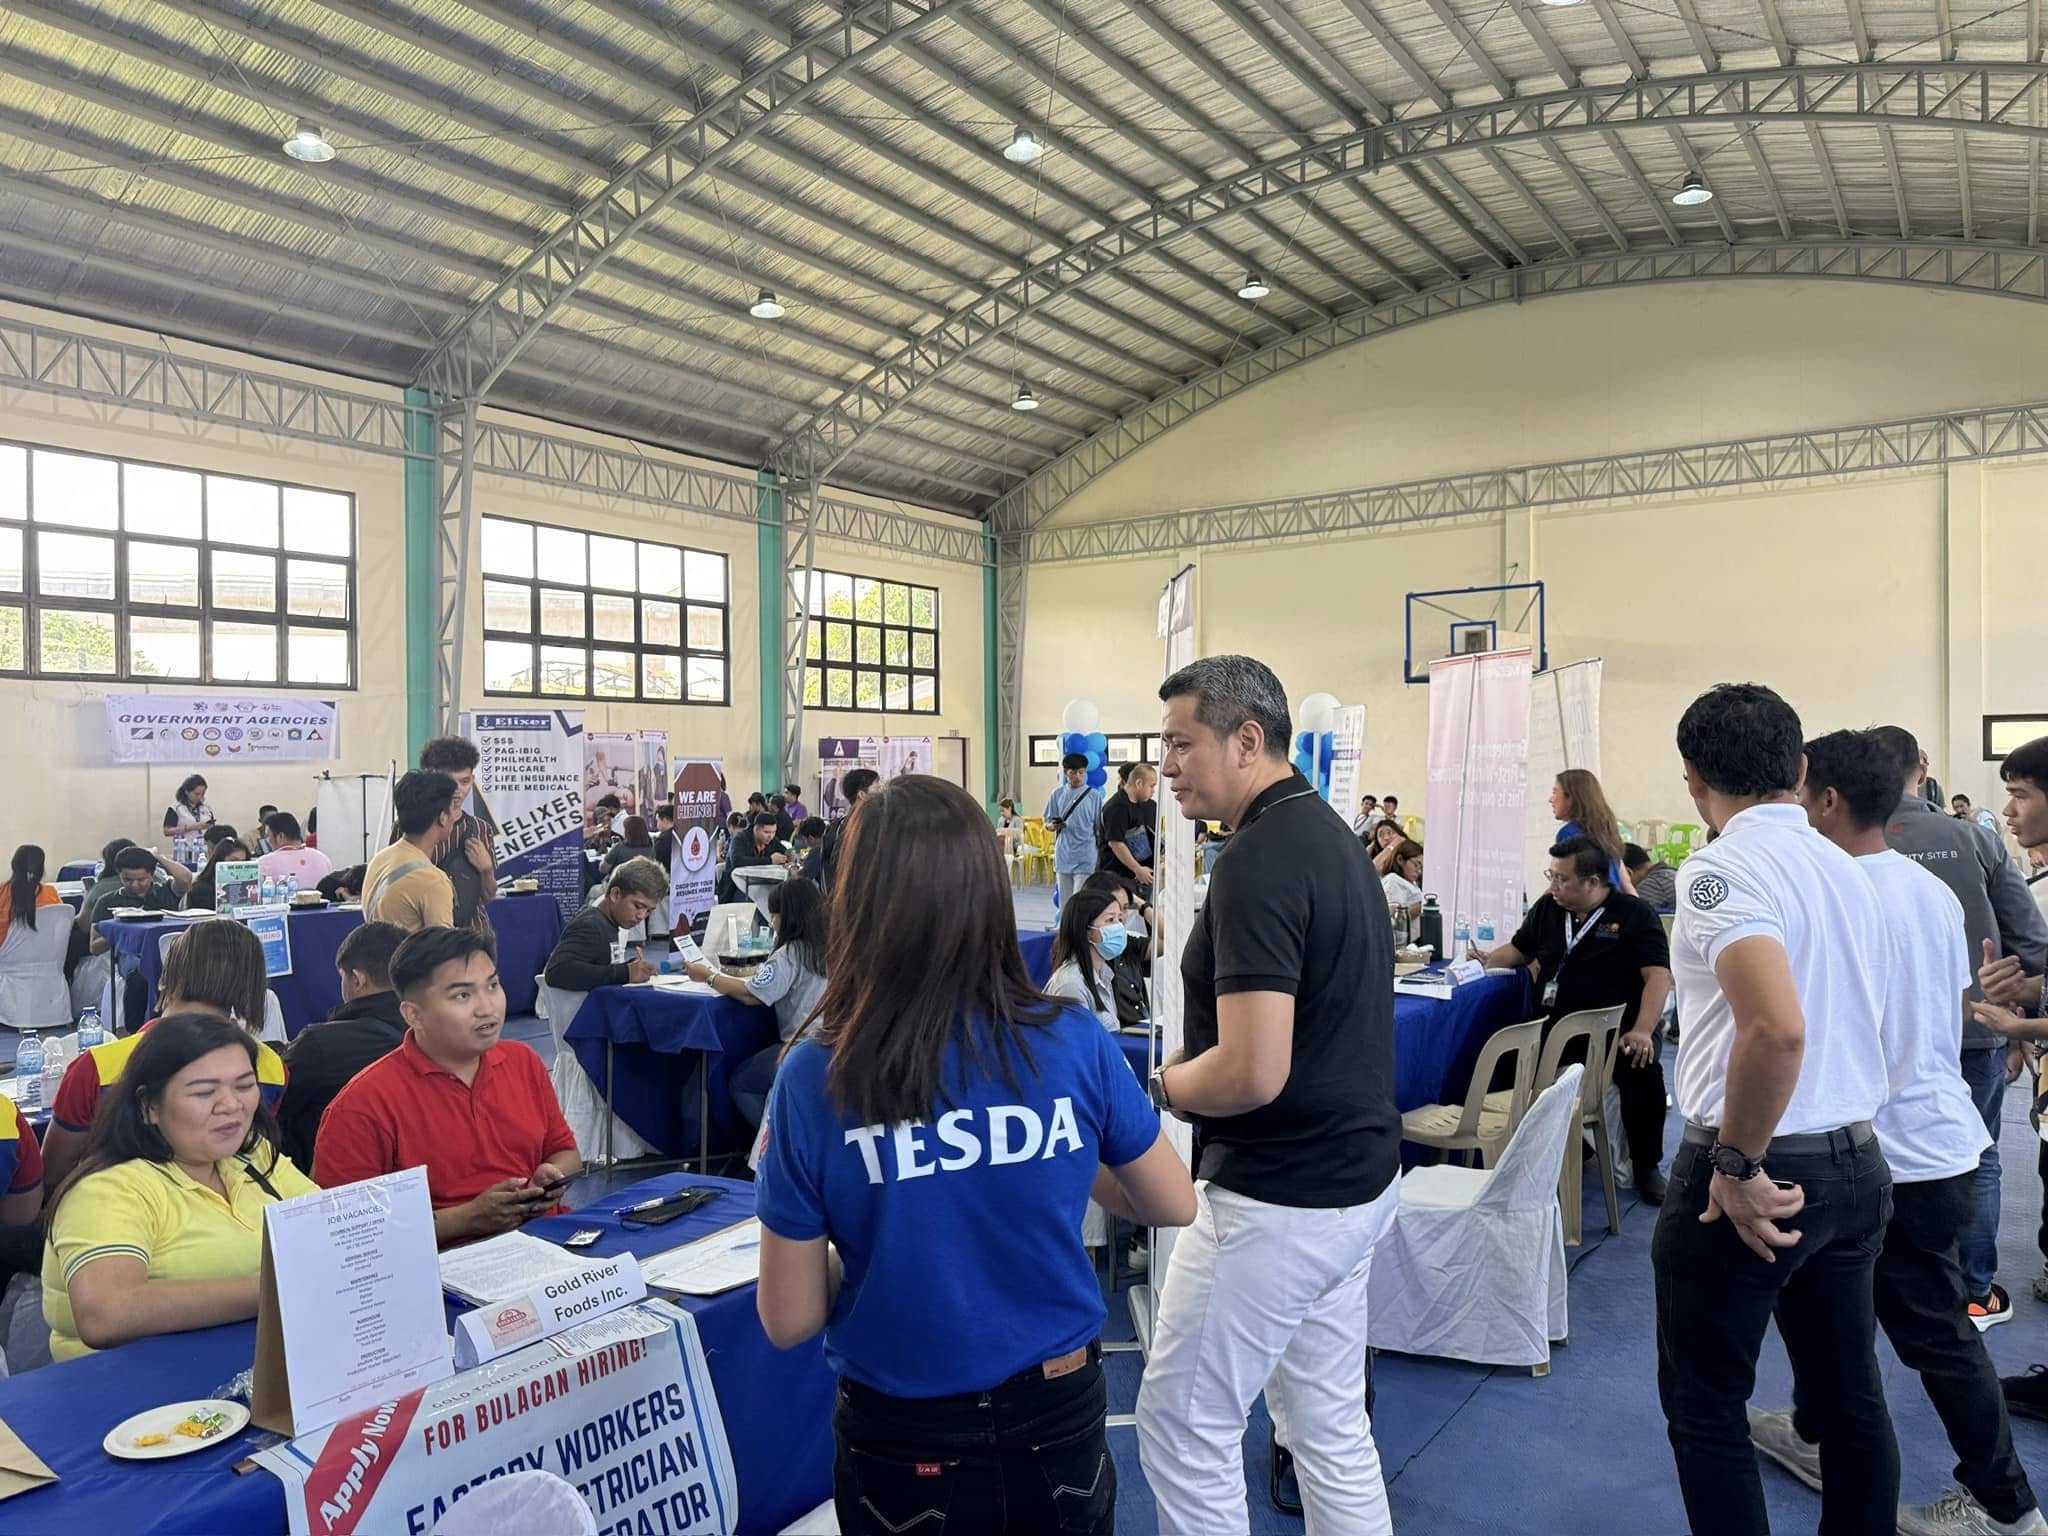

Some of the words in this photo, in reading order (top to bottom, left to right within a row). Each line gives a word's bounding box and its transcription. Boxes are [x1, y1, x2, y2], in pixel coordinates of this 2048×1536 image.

[118, 714, 242, 725] GOVERNMENT
[248, 716, 329, 726] AGENCIES
[495, 716, 550, 726] Elixer
[493, 737, 514, 745] SSS
[494, 747, 541, 755] PAG-IBIG
[494, 765, 547, 773] PHILCARE
[494, 774, 517, 782] LIFE
[520, 774, 580, 782] INSURANCE
[494, 784, 521, 792] FREE
[678, 791, 696, 804] WE
[696, 790, 717, 804] ARE
[501, 791, 582, 837] ELIXER
[1926, 851, 1949, 860] SITE
[844, 1097, 1085, 1185] TESDA
[328, 1214, 342, 1224] JOB
[544, 1274, 583, 1300] Gold
[582, 1261, 620, 1285] River
[554, 1294, 600, 1322] Foods
[602, 1283, 629, 1304] Inc.
[423, 1412, 466, 1457] FOR
[475, 1367, 570, 1433] BULACAN
[576, 1338, 649, 1387] HIRING!
[431, 1391, 471, 1409] GOLD
[555, 1382, 685, 1477] WORKERS
[320, 1438, 380, 1532] Apply
